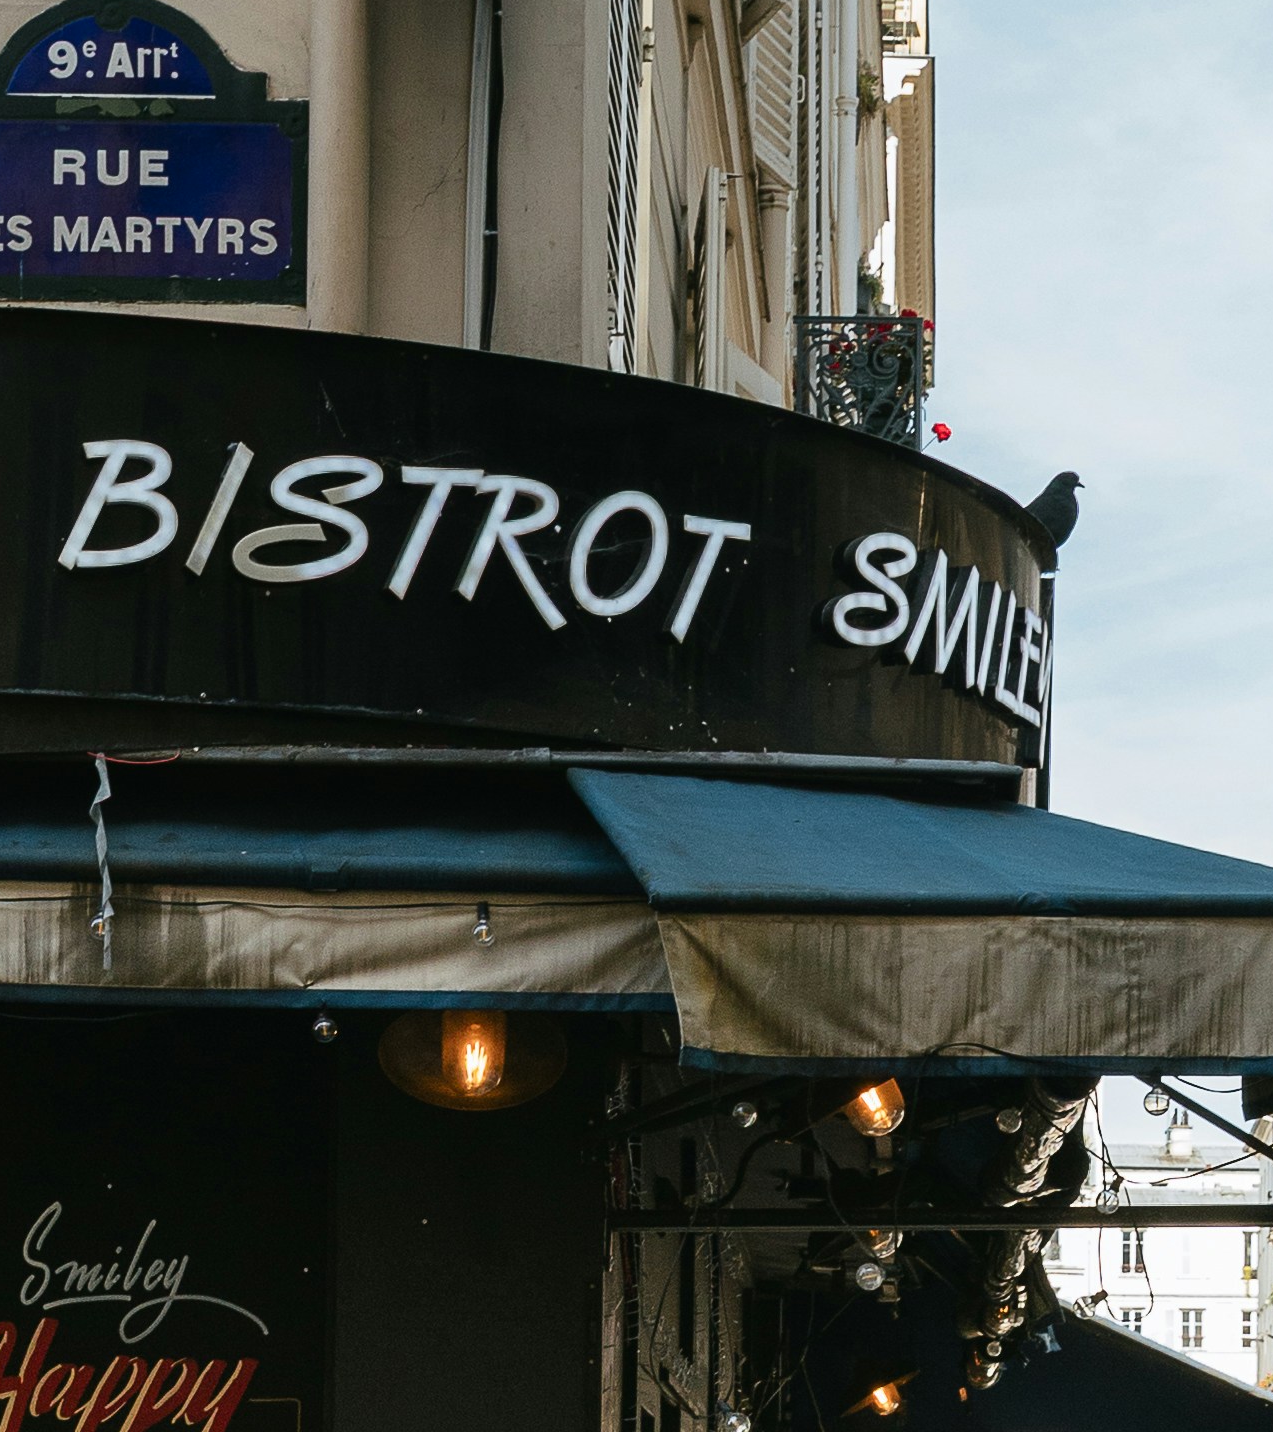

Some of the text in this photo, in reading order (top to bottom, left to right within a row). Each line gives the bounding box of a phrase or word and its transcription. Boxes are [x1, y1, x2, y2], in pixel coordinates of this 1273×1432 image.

[51, 148, 170, 188] RUE
[52, 215, 278, 257] MARTYRS
[57, 437, 753, 645] BISTROT
[20, 1201, 269, 1344] Smiley
